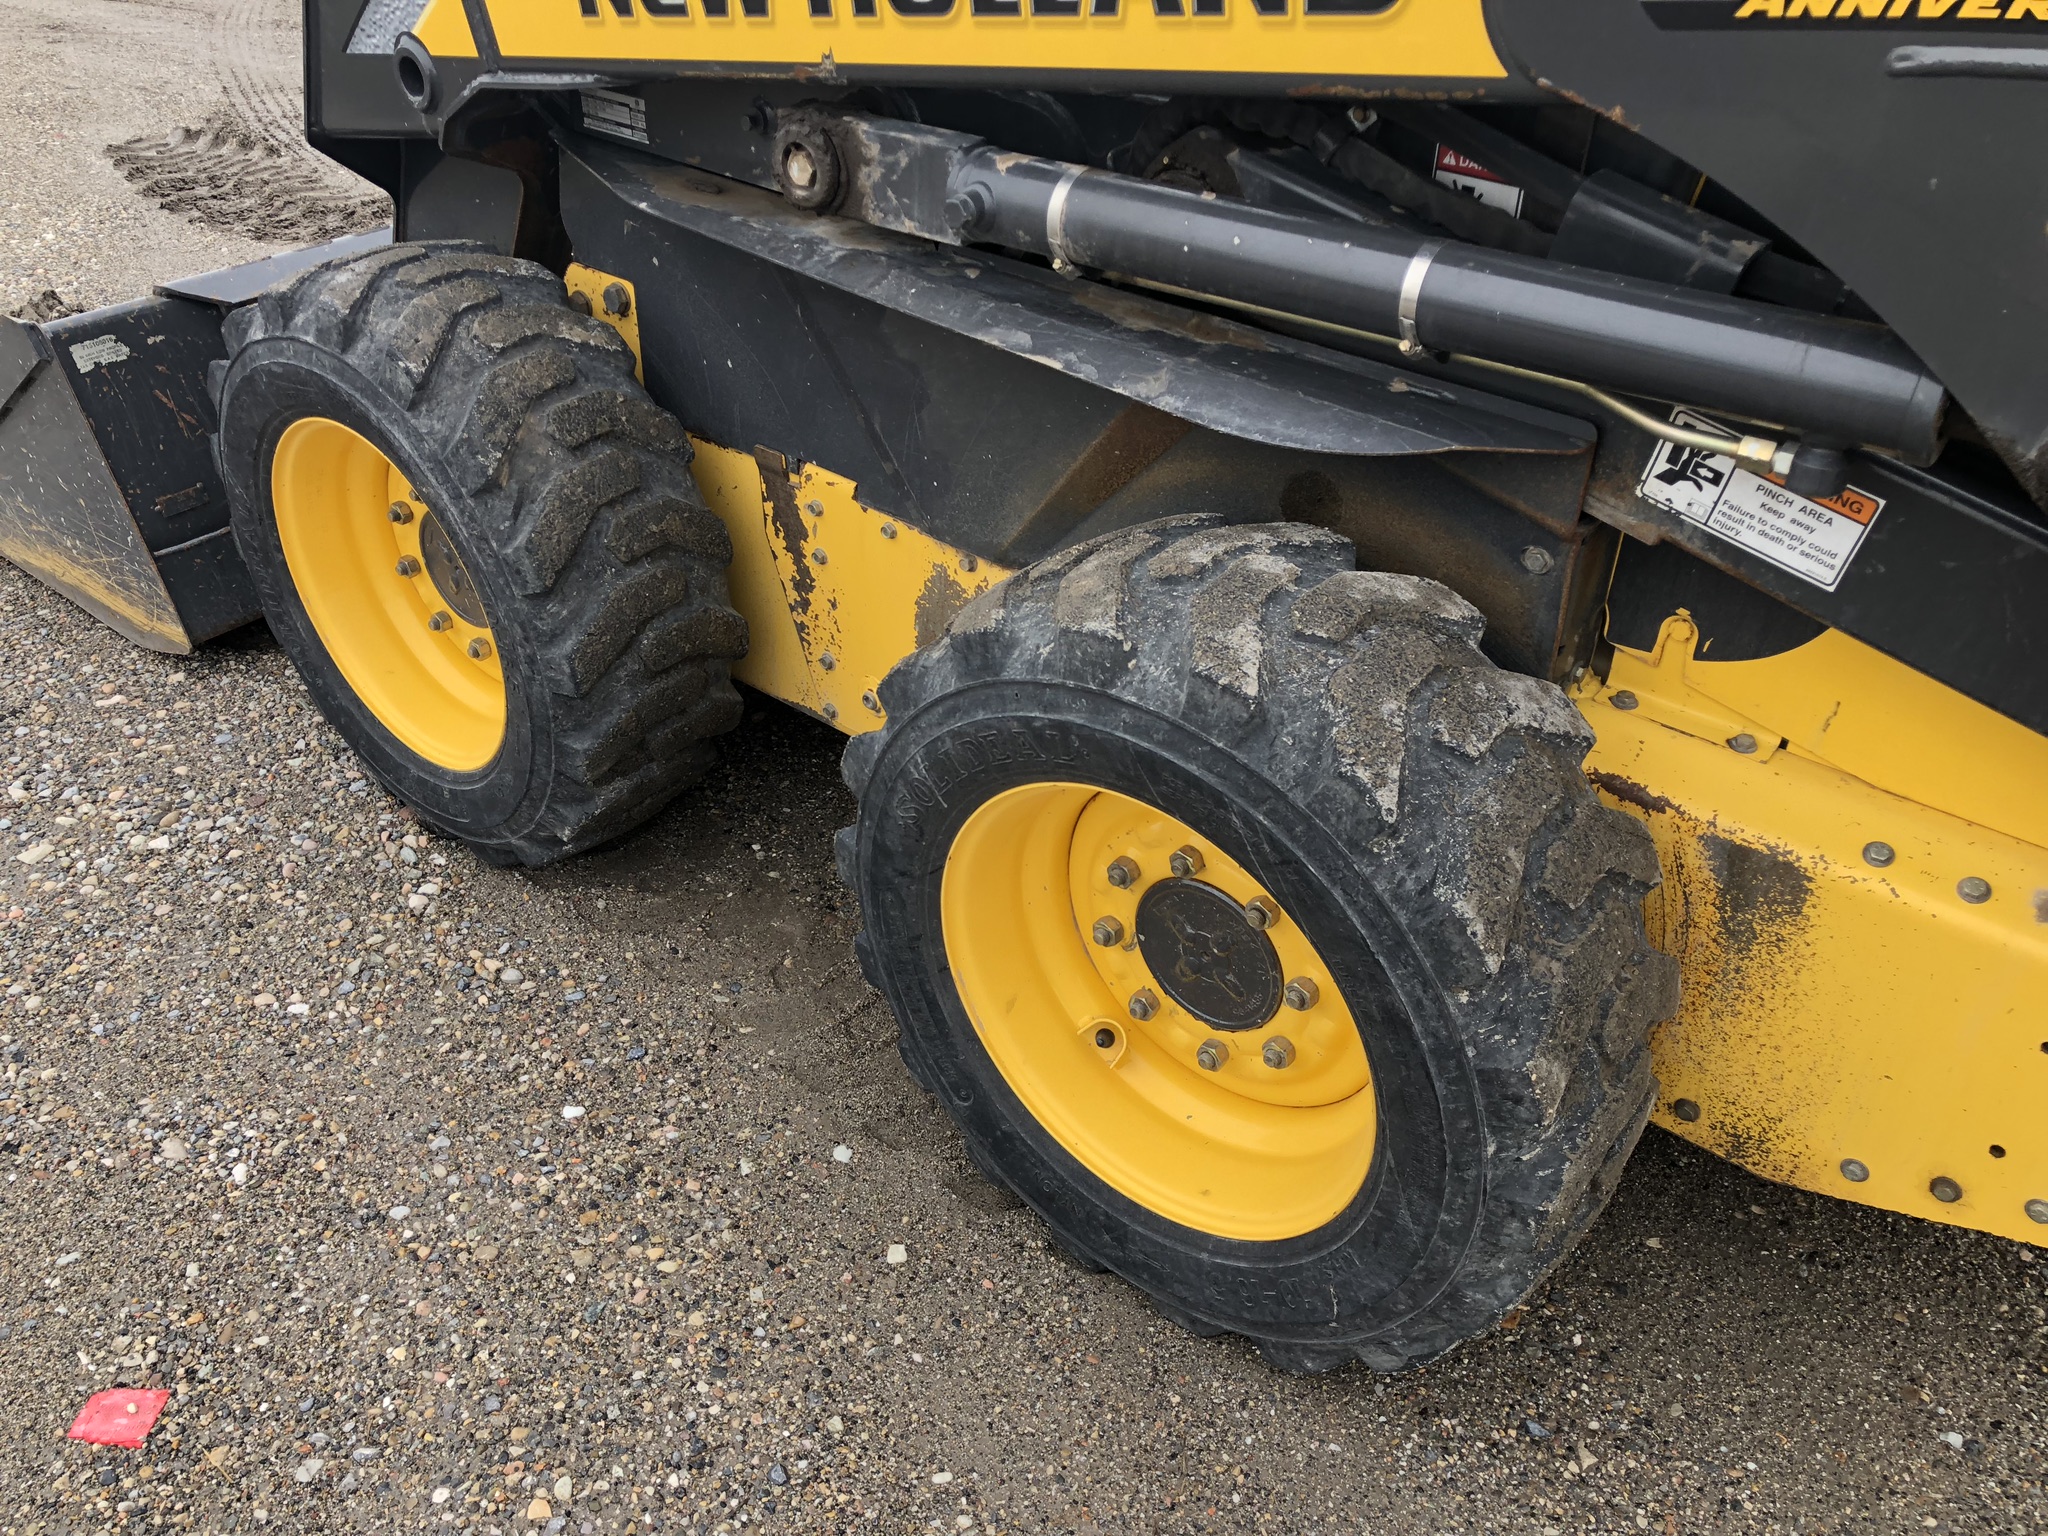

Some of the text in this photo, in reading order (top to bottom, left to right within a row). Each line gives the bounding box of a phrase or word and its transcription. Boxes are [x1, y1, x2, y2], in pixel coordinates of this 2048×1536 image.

[1712, 516, 1742, 537] injury.
[1755, 484, 1834, 527] PINCH AREA
[1759, 501, 1817, 535] Keep away
[1717, 509, 1837, 571] result in death or serious
[1721, 499, 1838, 560] Failure to comply could
